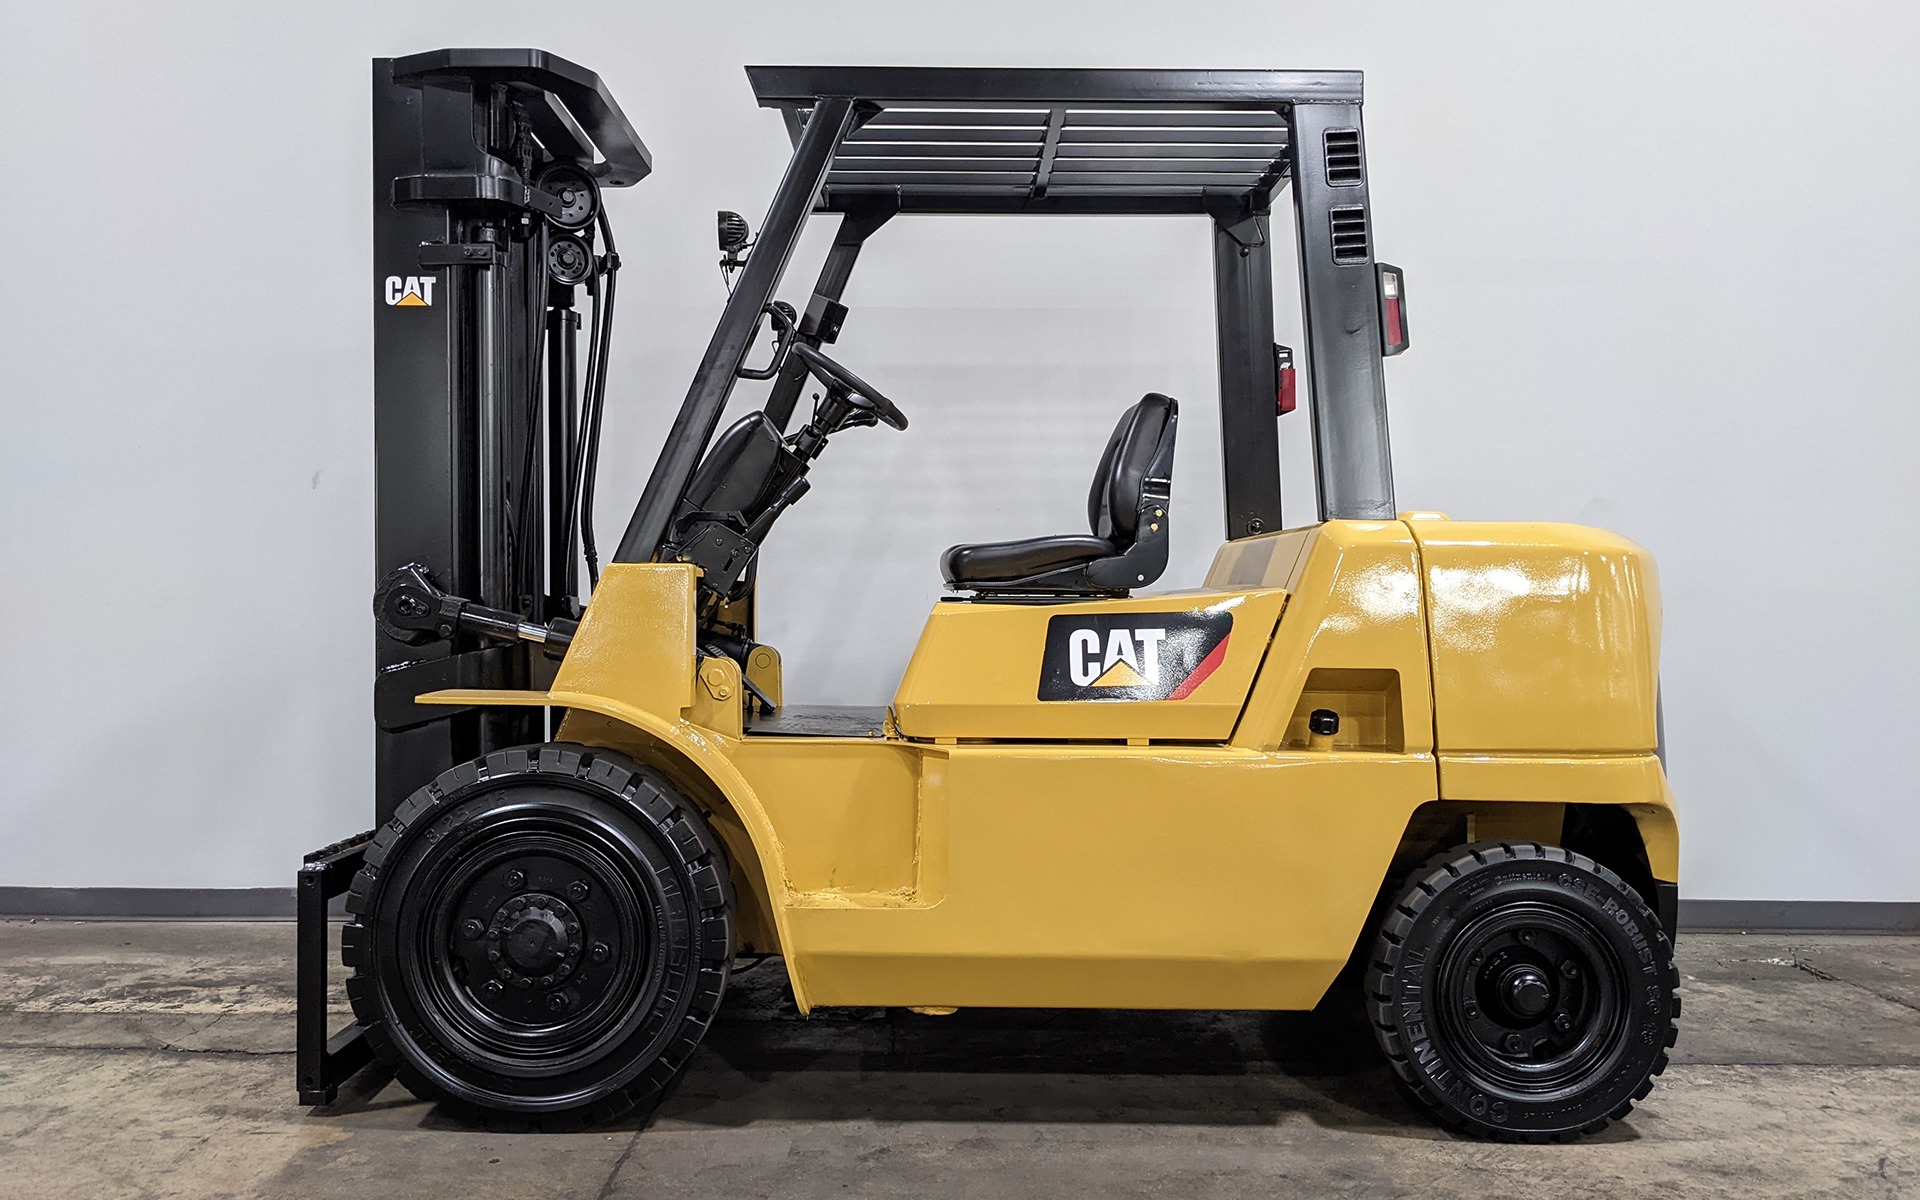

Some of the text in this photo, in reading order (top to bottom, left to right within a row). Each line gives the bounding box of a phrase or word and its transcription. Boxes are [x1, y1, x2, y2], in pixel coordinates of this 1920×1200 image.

[385, 275, 437, 307] CAT
[1069, 629, 1166, 688] CAT
[1557, 873, 1658, 975] CSE-ROBUST
[1402, 948, 1509, 1123] CONTINENTAL
